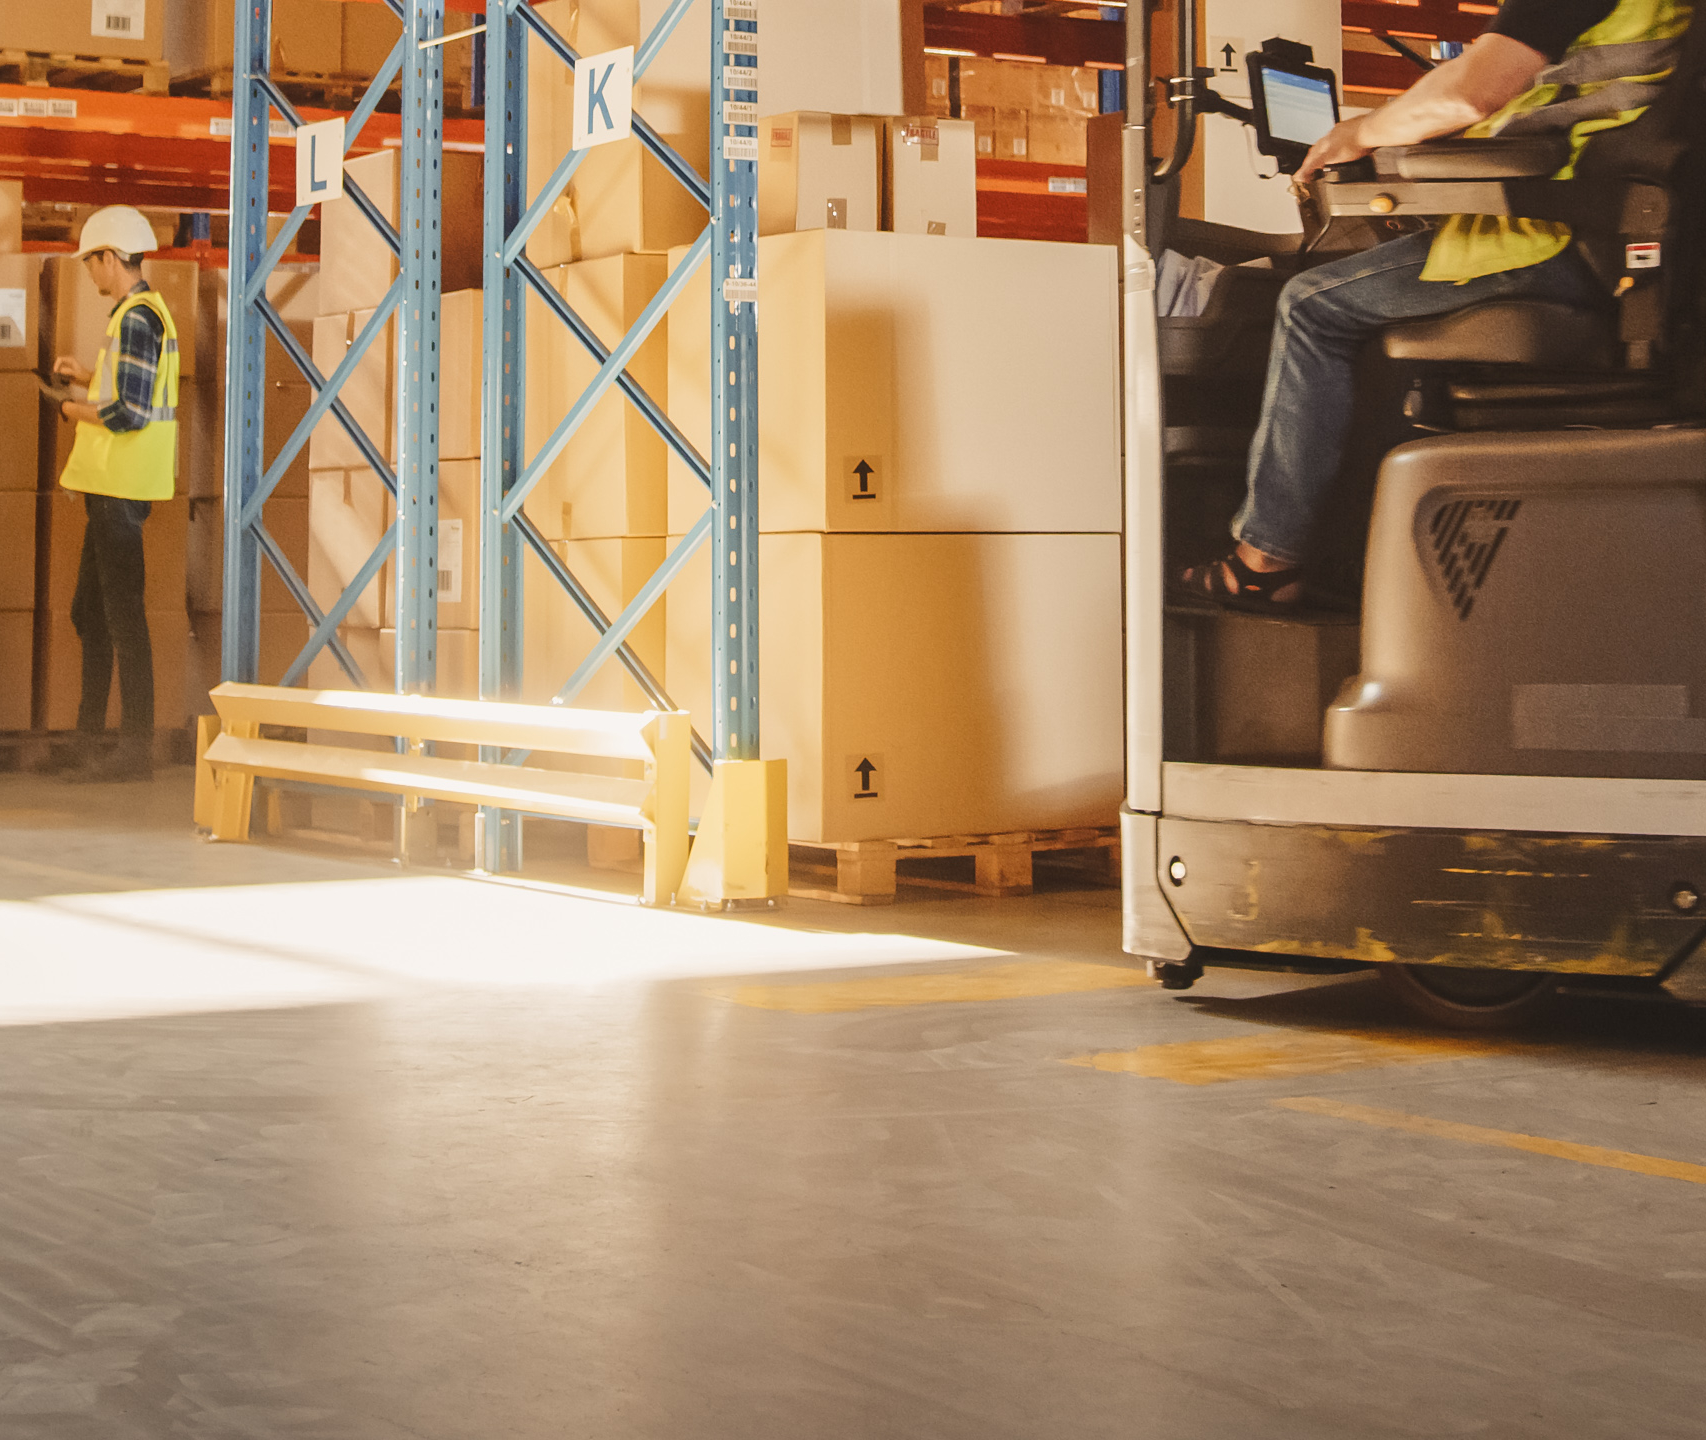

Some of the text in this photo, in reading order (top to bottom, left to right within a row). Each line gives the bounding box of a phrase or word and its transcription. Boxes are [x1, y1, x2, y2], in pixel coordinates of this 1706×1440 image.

[729, 0, 752, 7] 10/44/4
[587, 62, 615, 135] K
[730, 103, 753, 111] 10/44/1
[311, 134, 327, 192] L
